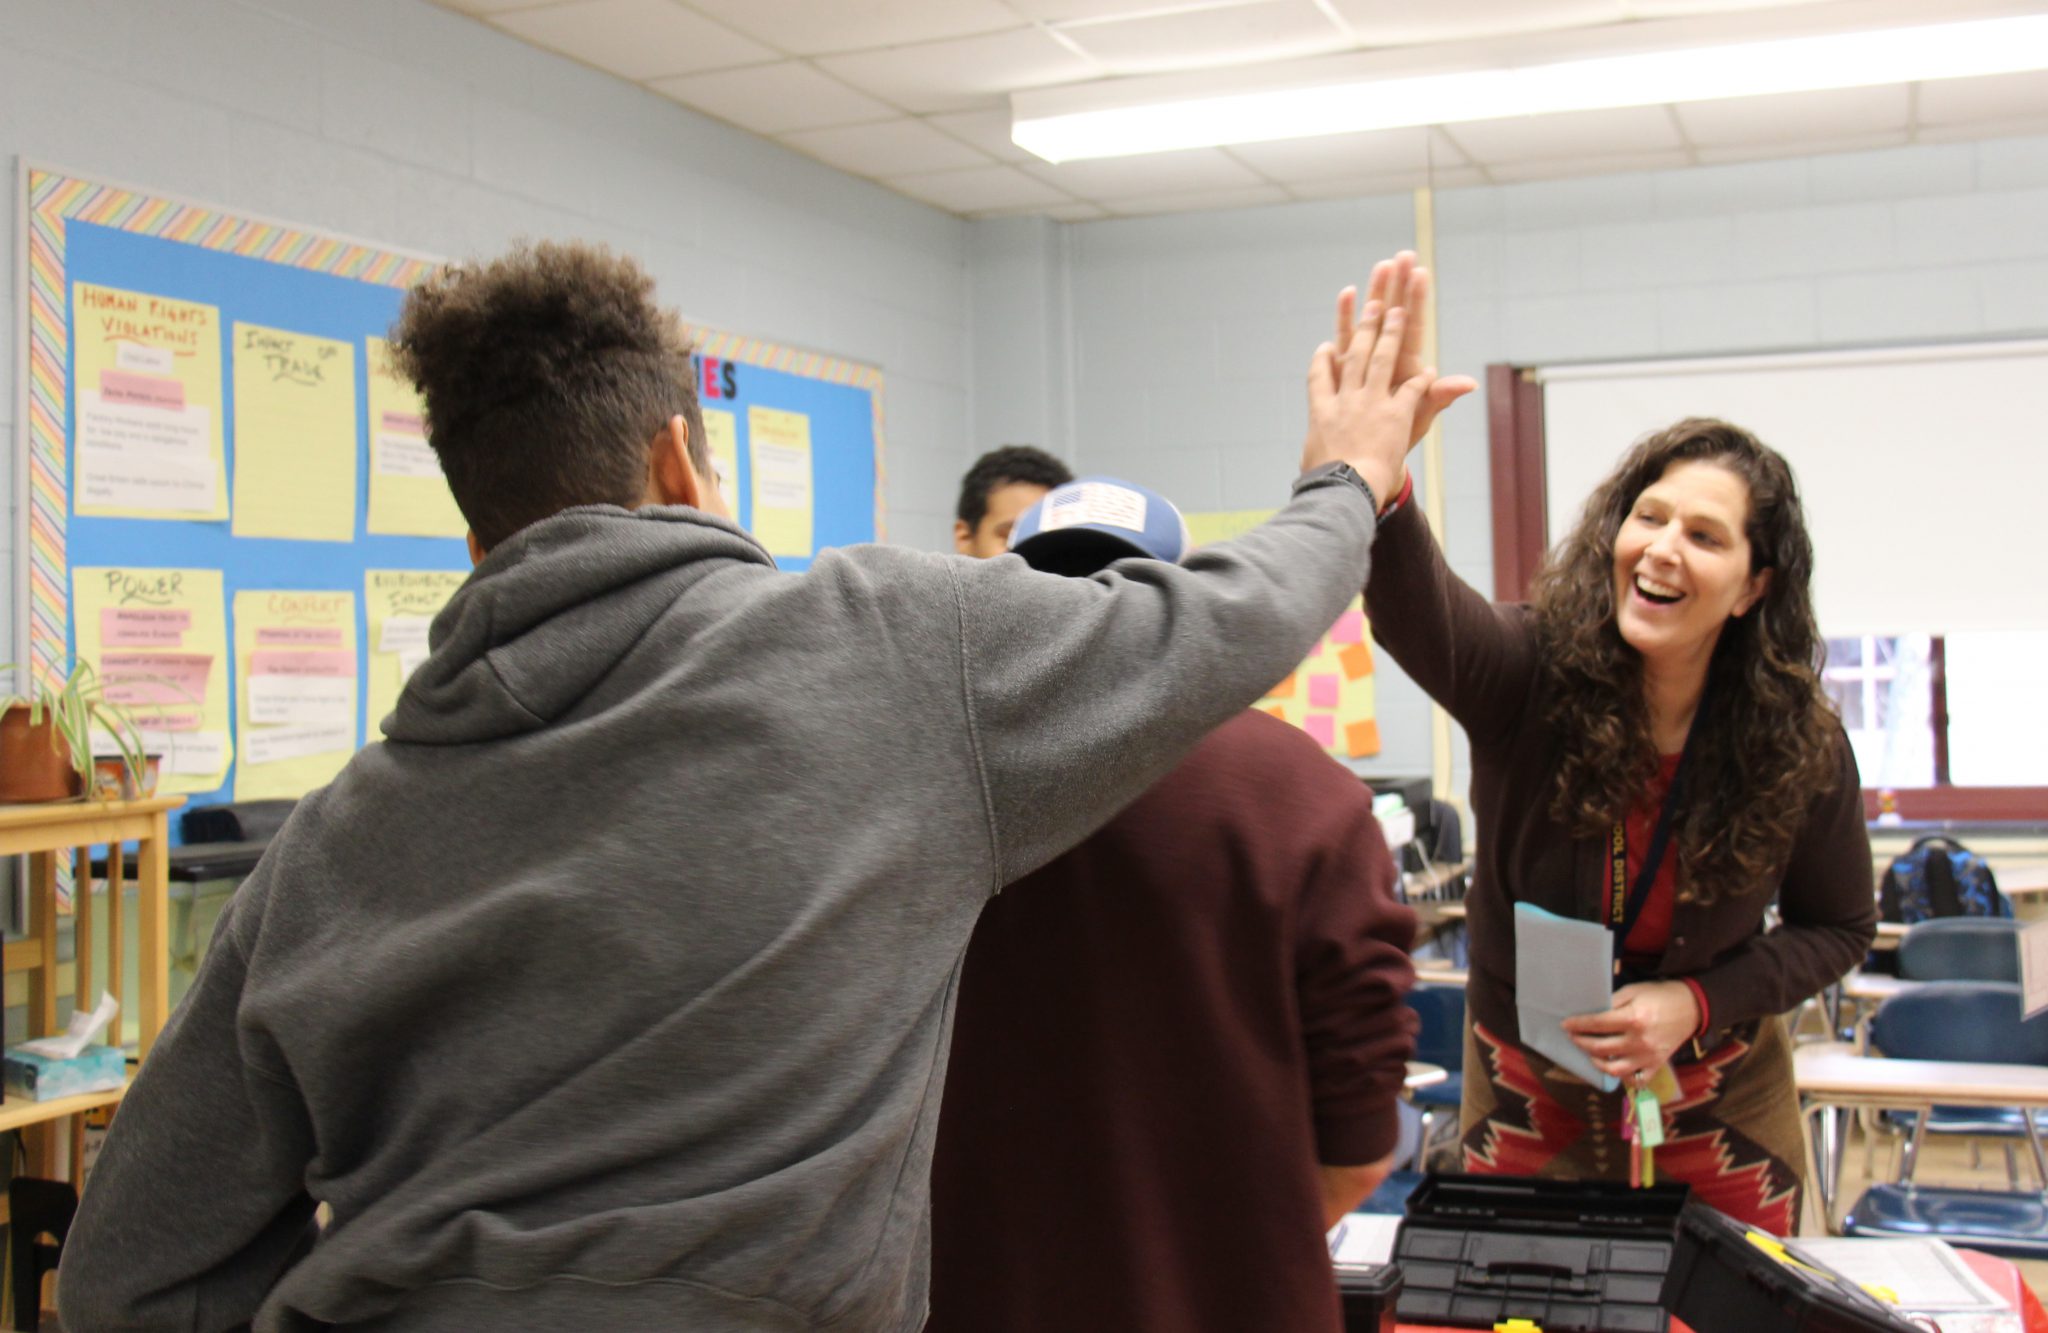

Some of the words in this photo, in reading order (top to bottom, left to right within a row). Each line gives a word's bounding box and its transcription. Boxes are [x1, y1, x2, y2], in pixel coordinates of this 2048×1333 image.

[82, 285, 138, 312] HUMAN
[149, 299, 208, 326] RIGHTS
[101, 315, 199, 346] VIOLATIONS
[105, 570, 185, 597] POWER
[1612, 858, 1626, 924] DISTRICT
